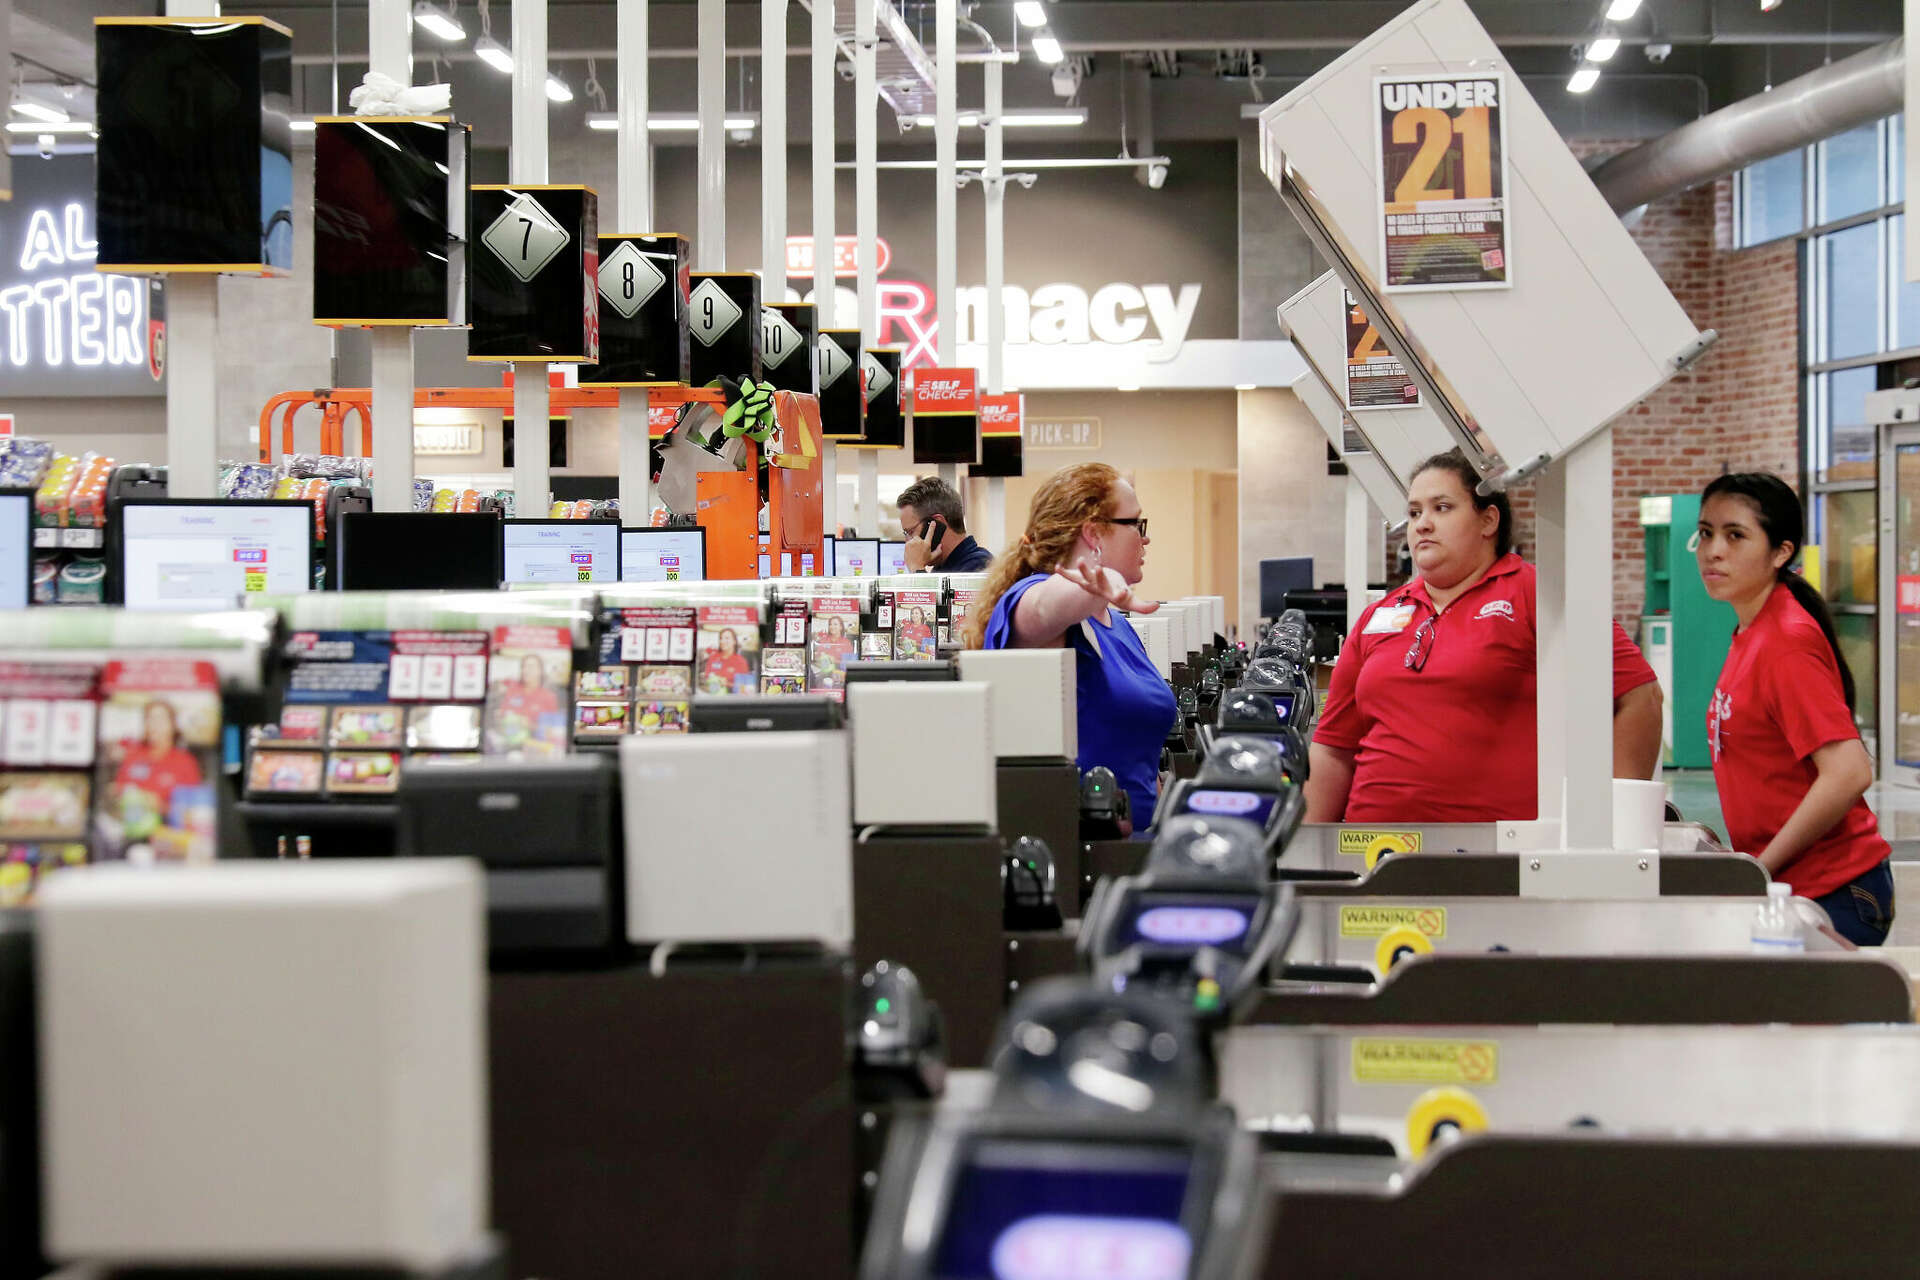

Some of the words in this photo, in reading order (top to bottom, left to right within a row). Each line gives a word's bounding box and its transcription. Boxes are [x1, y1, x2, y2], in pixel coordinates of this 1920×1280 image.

[1383, 80, 1499, 112] UNDER
[1392, 107, 1492, 201] 21
[518, 217, 533, 261] 7
[622, 262, 635, 300] 8
[703, 296, 714, 330] 9
[763, 325, 782, 354] 10
[1351, 305, 1389, 358] 2
[867, 367, 876, 391] 2
[931, 380, 960, 390] SELF
[918, 389, 959, 400] CHECK
[1030, 424, 1090, 444] PICK-UP
[1343, 834, 1378, 844] WARN
[1346, 911, 1416, 922] WARNING
